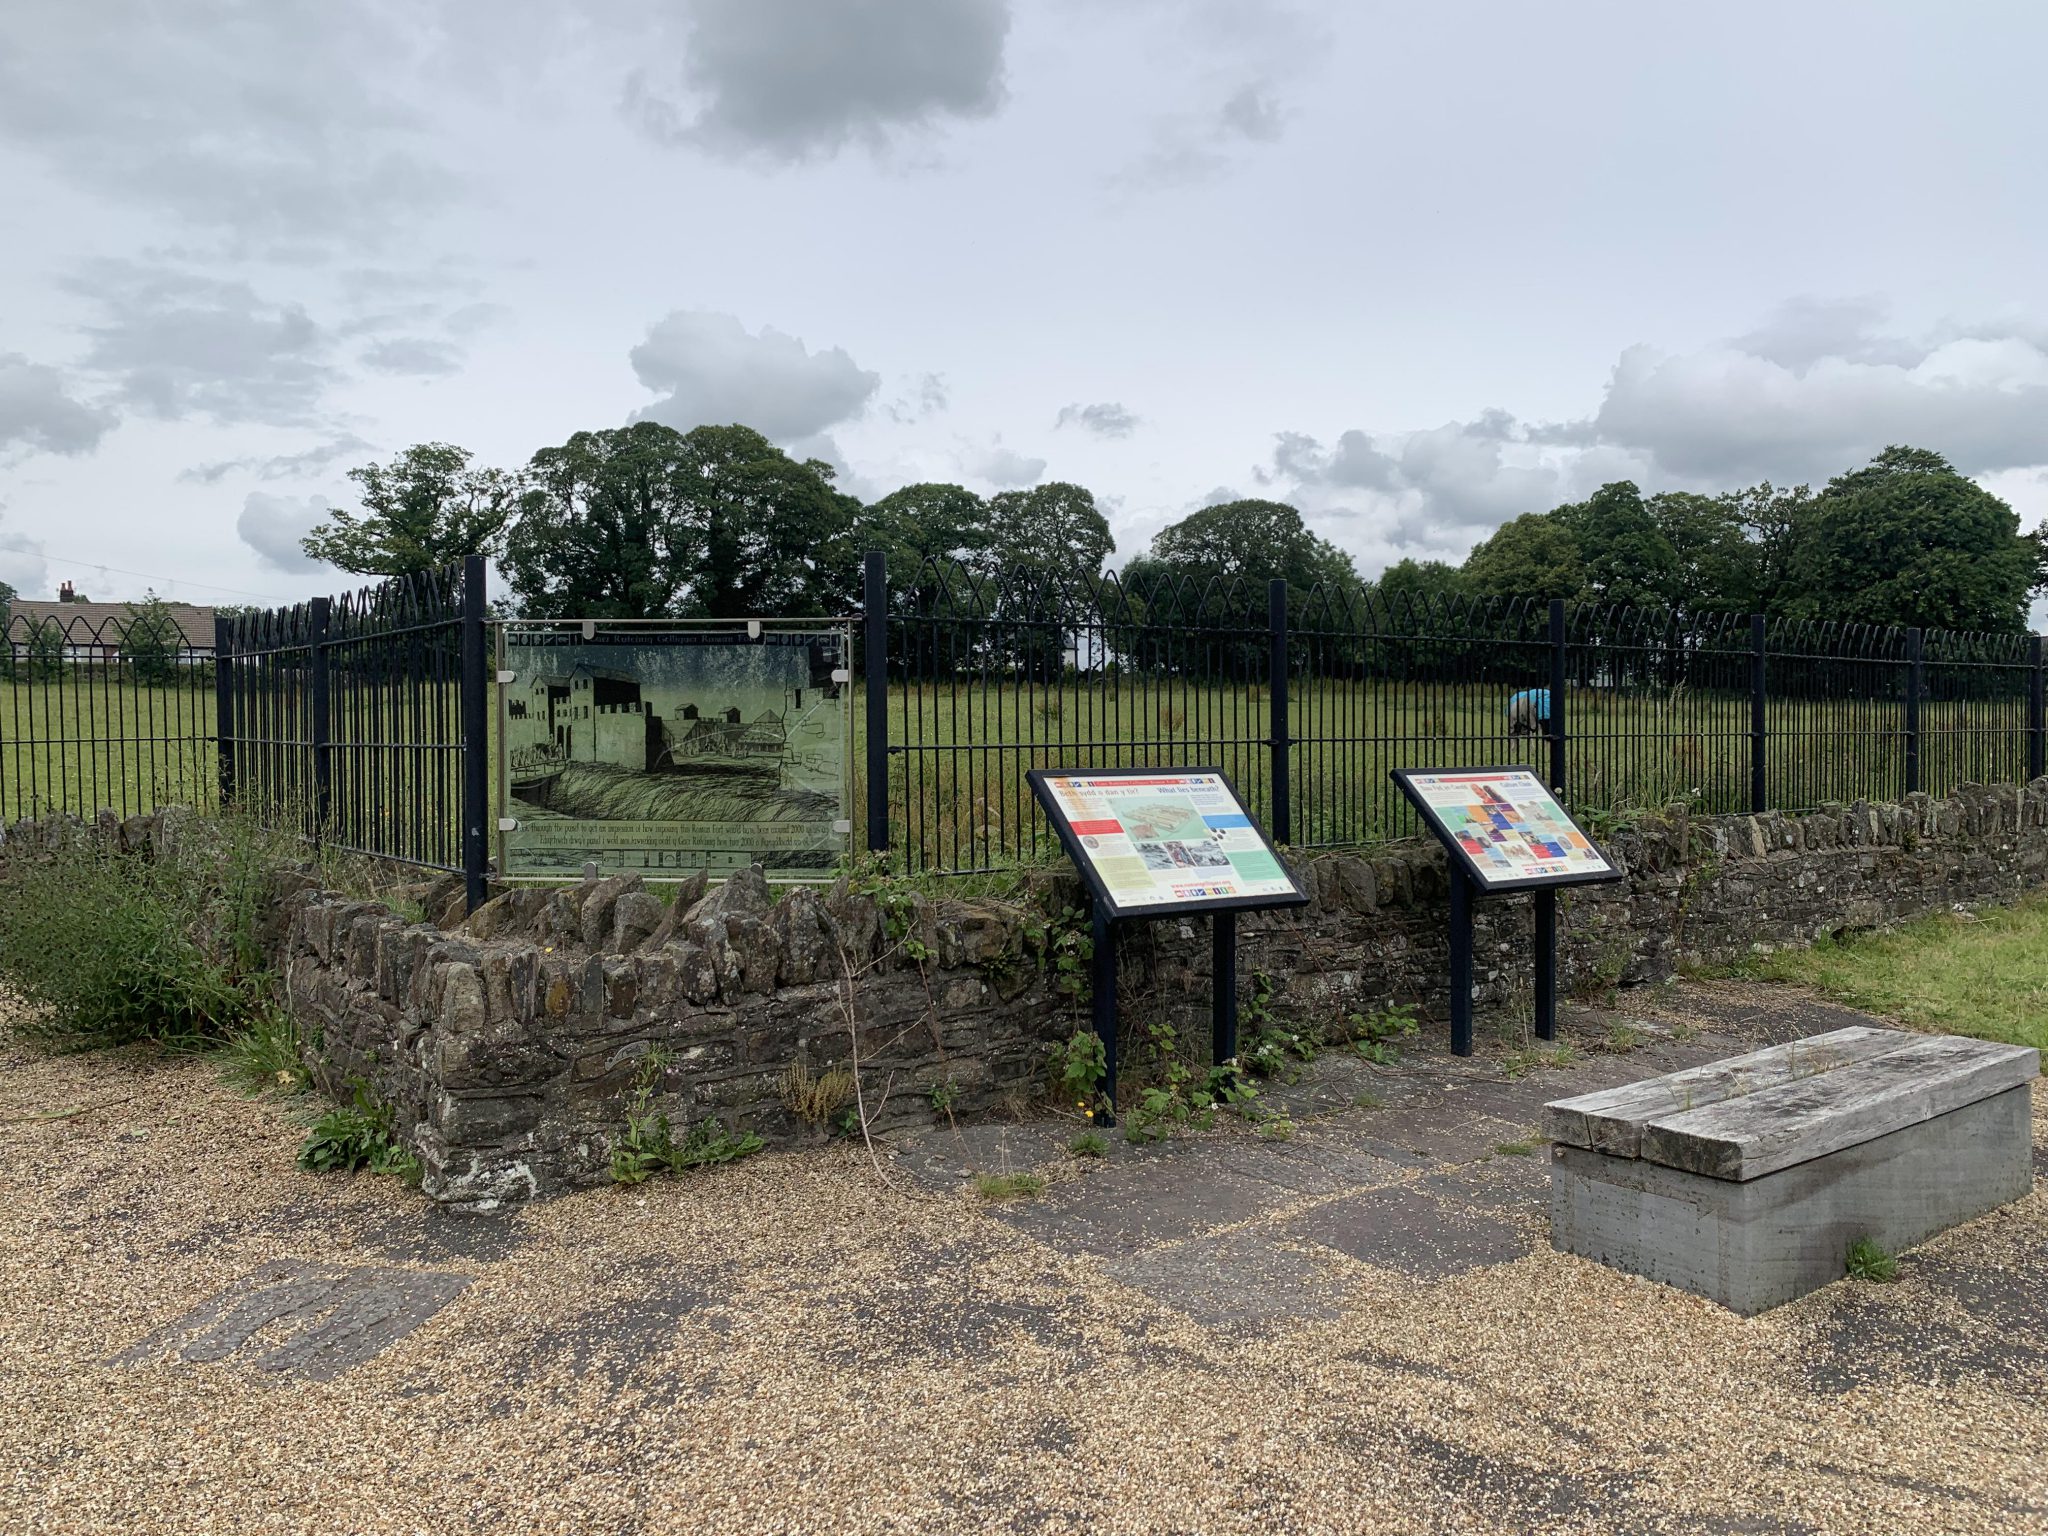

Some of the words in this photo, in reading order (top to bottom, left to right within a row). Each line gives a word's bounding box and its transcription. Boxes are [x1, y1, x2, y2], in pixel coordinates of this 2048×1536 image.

[1189, 785, 1219, 793] beneath?
[554, 823, 562, 832] the
[565, 823, 579, 835] panel
[581, 823, 587, 832] to
[643, 823, 653, 832] how
[692, 823, 711, 833] Roman
[713, 824, 723, 833] Fort
[791, 824, 804, 834] 2000
[741, 837, 754, 847] 2000
